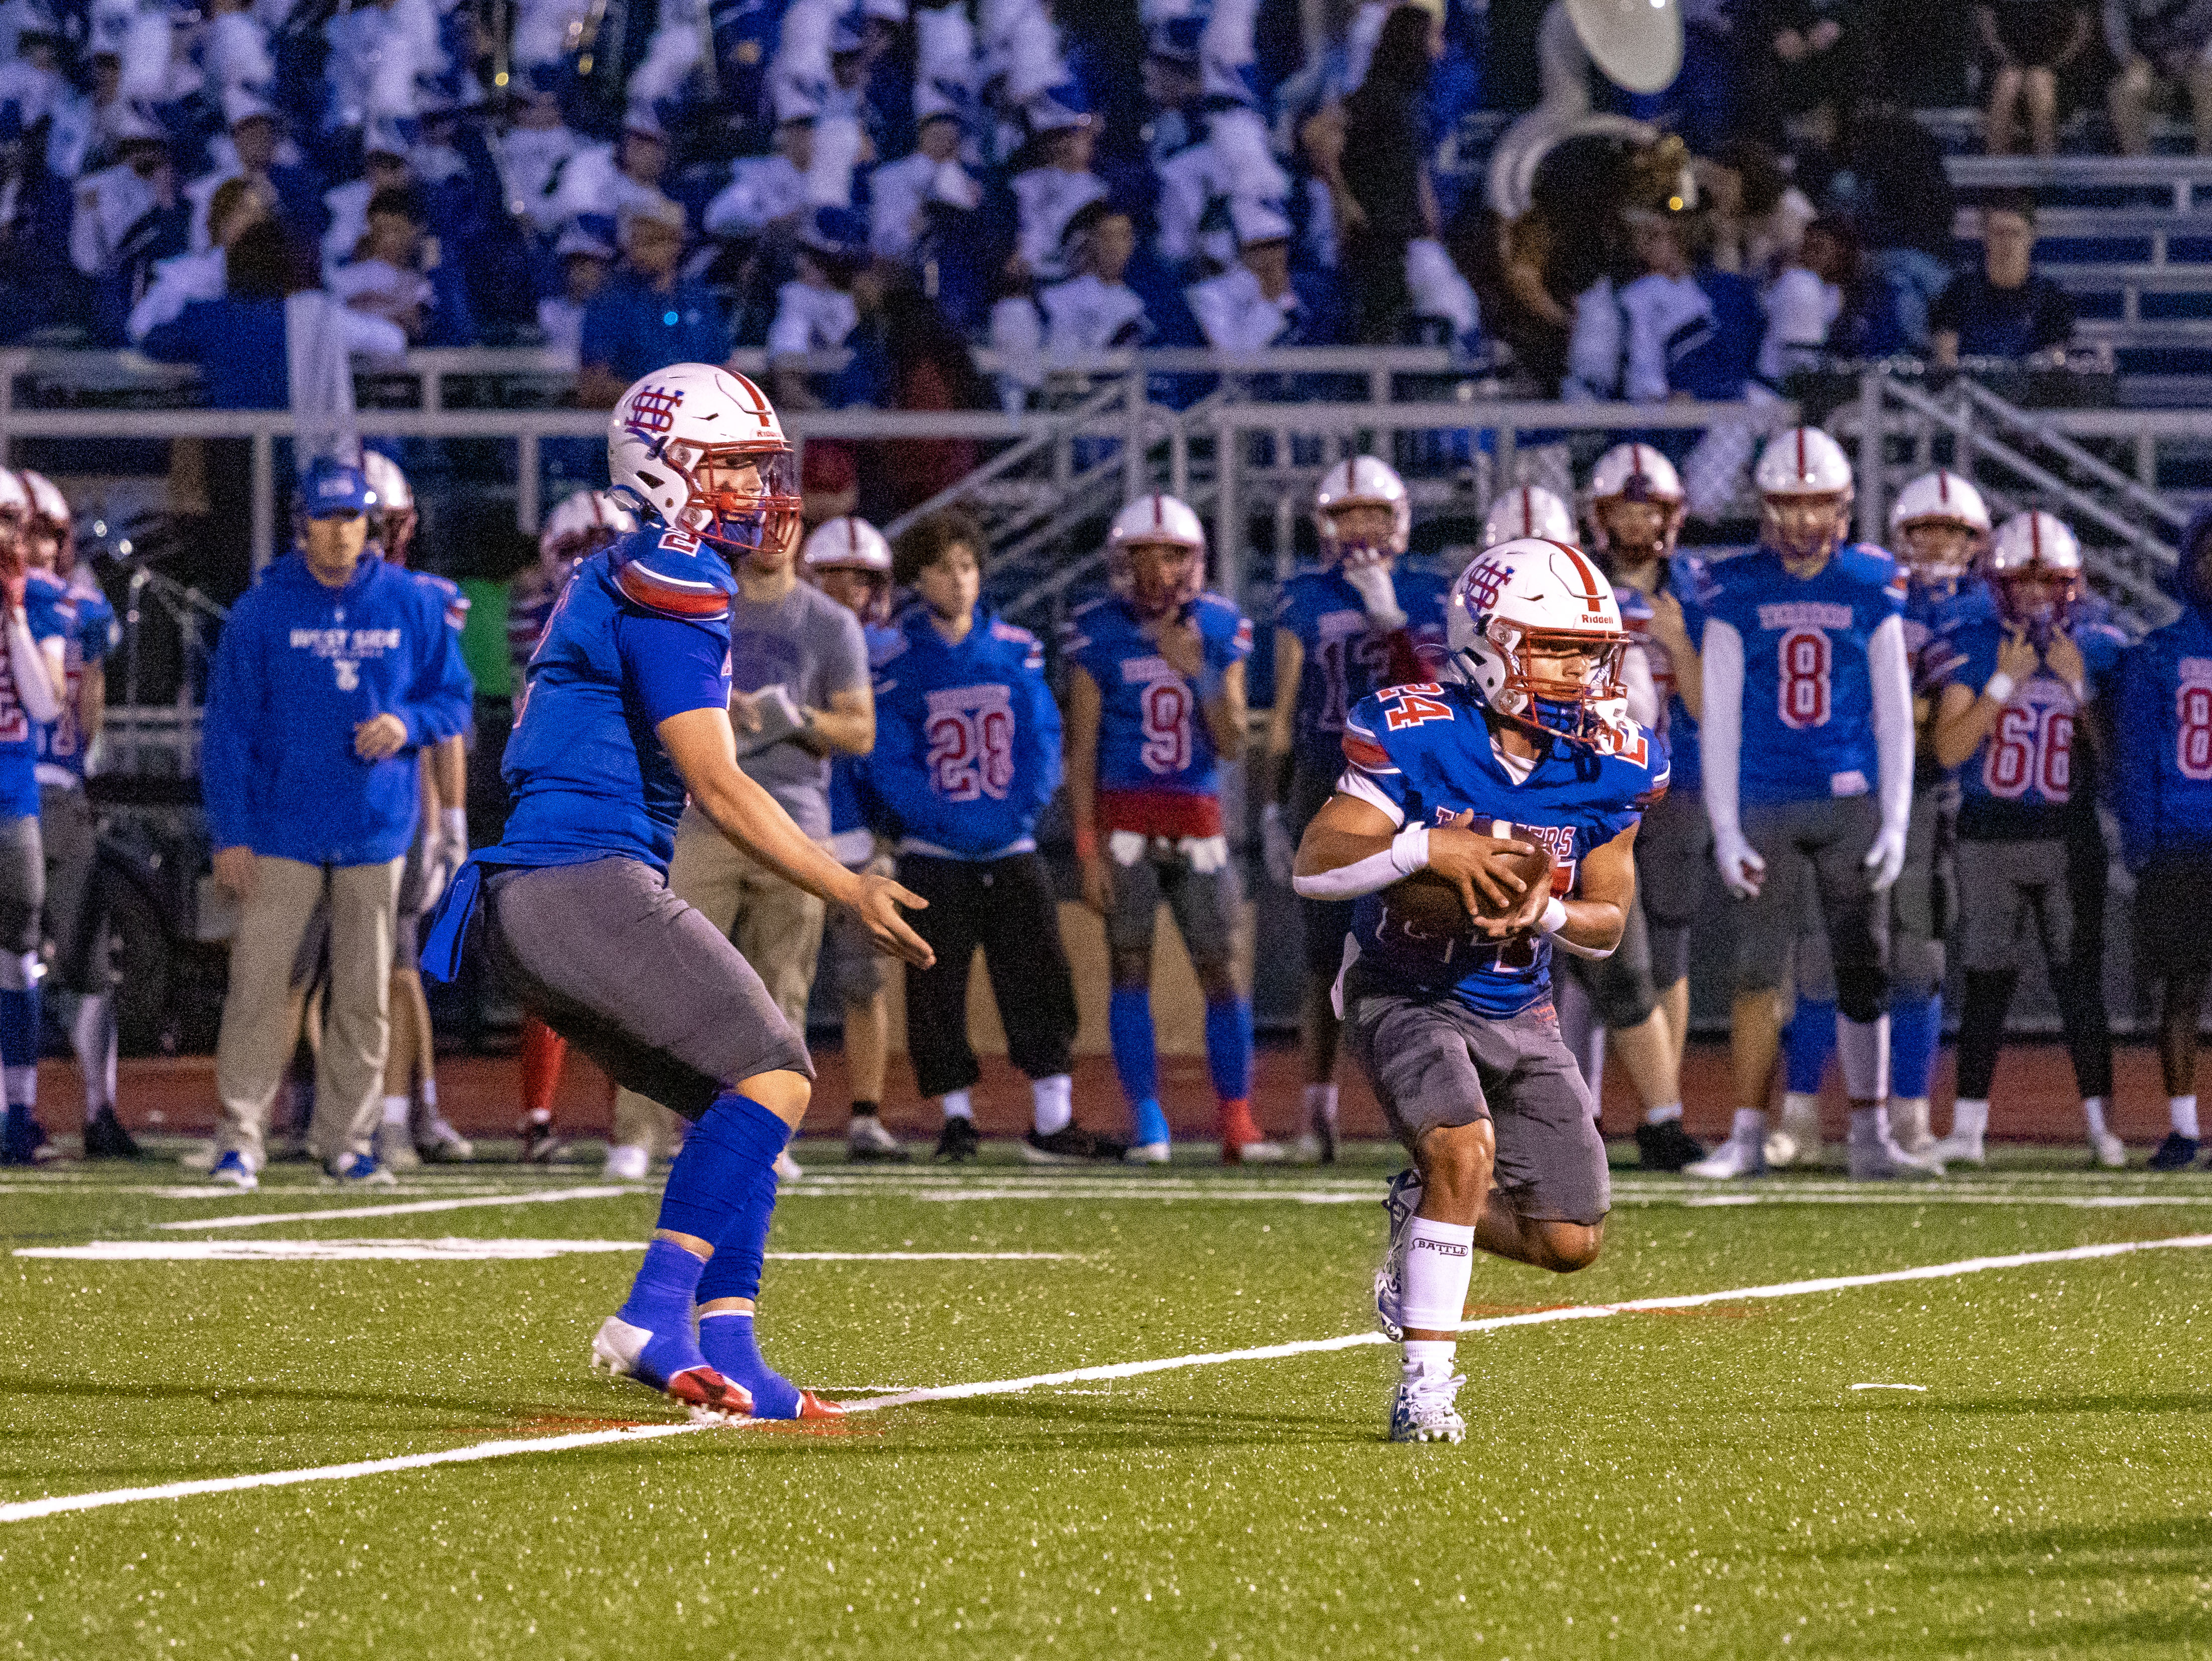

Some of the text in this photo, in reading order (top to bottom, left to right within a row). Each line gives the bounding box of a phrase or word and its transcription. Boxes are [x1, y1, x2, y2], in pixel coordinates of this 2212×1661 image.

[1582, 614, 1613, 624] Riddell
[1778, 628, 1832, 730] 8
[1140, 679, 1194, 774] 9
[1375, 682, 1454, 731] 24
[1418, 1240, 1466, 1255] BATTLE
